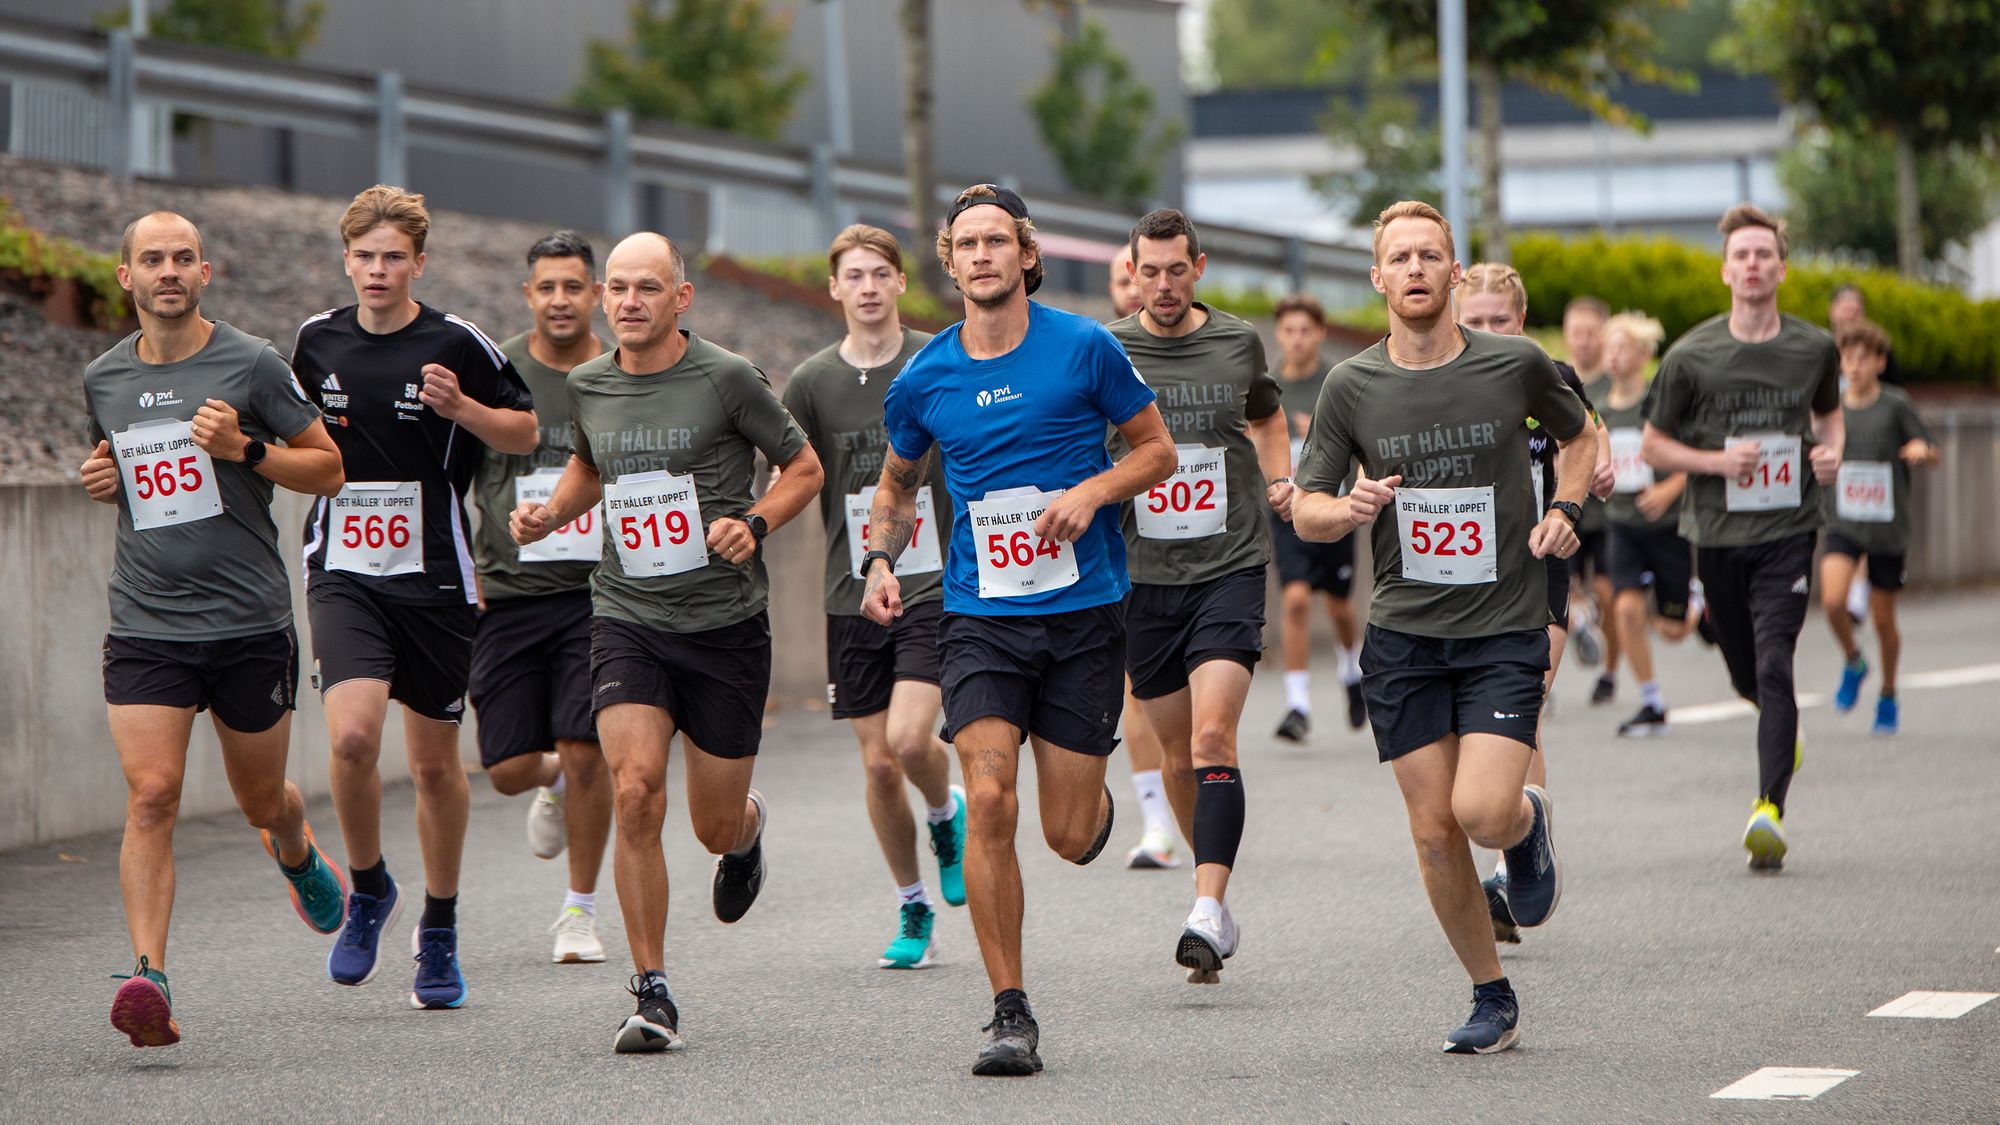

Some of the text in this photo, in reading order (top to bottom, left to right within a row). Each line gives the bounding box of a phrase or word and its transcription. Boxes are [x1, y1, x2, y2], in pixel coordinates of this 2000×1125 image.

[156, 389, 173, 402] pvi
[404, 383, 418, 398] 59
[992, 384, 1011, 400] pvi
[326, 401, 349, 409] SPORT
[121, 447, 135, 458] DET
[168, 437, 198, 451] LOPPE
[591, 431, 616, 454] DET
[1377, 434, 1411, 459] DET
[134, 455, 203, 500] 565
[1191, 461, 1218, 474] LOPPET
[1402, 454, 1475, 482] LOPPET
[336, 497, 350, 507] DET
[384, 497, 414, 507] LOPPET
[610, 500, 622, 509] DET
[658, 490, 688, 505] LOPPET
[1147, 479, 1216, 513] 502
[1402, 502, 1416, 512] DET
[1455, 502, 1486, 513] LOPPET
[342, 514, 410, 549] 566
[621, 510, 690, 550] 519
[976, 516, 989, 526] DET
[1411, 520, 1483, 556] 523
[988, 531, 1061, 569] 564
